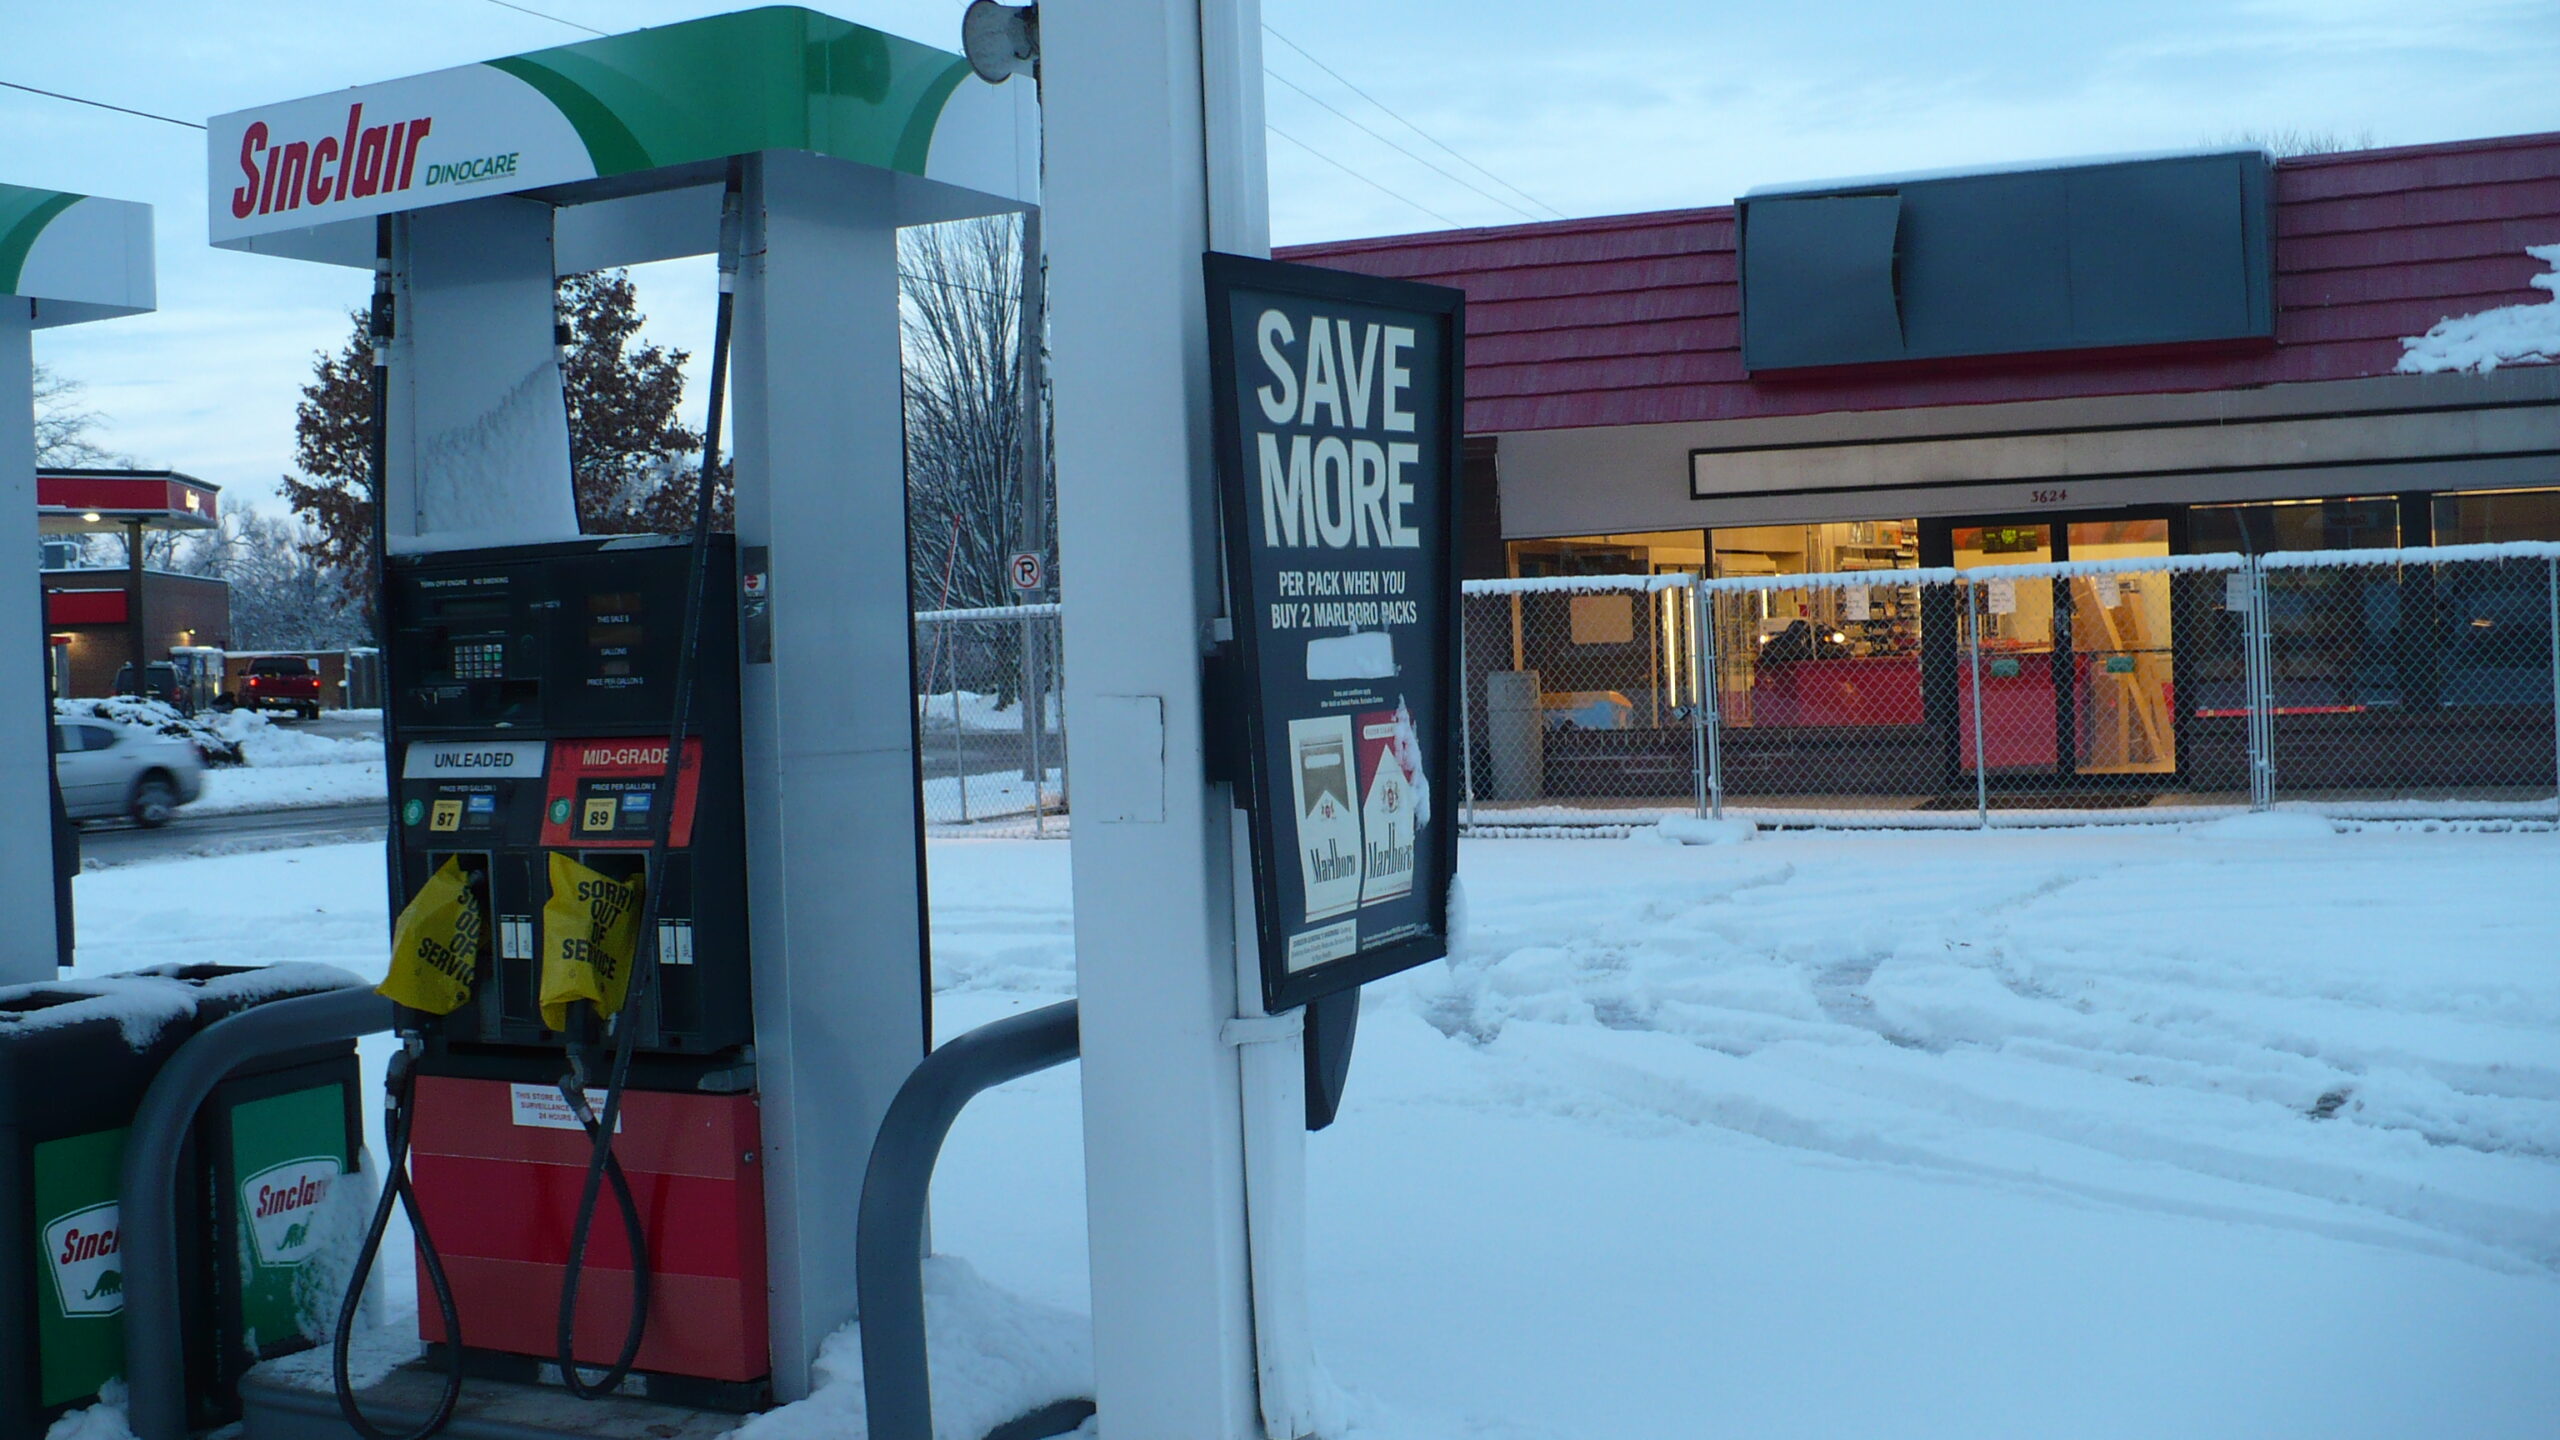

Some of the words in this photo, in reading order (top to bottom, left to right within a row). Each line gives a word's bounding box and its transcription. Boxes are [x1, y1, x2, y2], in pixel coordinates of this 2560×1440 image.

[232, 102, 432, 219] Sinclair
[426, 152, 520, 186] DINOCARE
[1257, 308, 1415, 432] SAVE
[1257, 432, 1420, 548] MORE
[1021, 561, 1035, 582] P
[1279, 571, 1304, 597] PER
[1307, 571, 1340, 597] PACK
[1342, 571, 1379, 596] WHEN
[1381, 571, 1406, 595] YOU
[1271, 603, 1299, 629] BUY
[1301, 602, 1312, 628] 2
[1313, 601, 1379, 628] MARLBORO
[1380, 600, 1418, 626] PACKS
[434, 752, 514, 770] UNLEADED
[583, 748, 669, 768] MID-GRADE
[591, 783, 610, 791] PRICE
[611, 783, 624, 791] PER
[625, 783, 651, 791] GALLON
[437, 812, 456, 827] 87
[590, 810, 609, 826] 89
[1309, 837, 1356, 884] Marlboro
[578, 880, 634, 912] SORRY
[456, 911, 480, 939] OU
[591, 899, 622, 929] OUT
[450, 933, 477, 960] OF
[591, 922, 607, 946] OF
[417, 937, 476, 987] SERVIC
[562, 938, 617, 980] SERVICE
[521, 1101, 570, 1112] SURVEILLANCE
[532, 1092, 553, 1101] STORE
[549, 1114, 572, 1122] HOURS
[61, 1226, 120, 1265] Sincl
